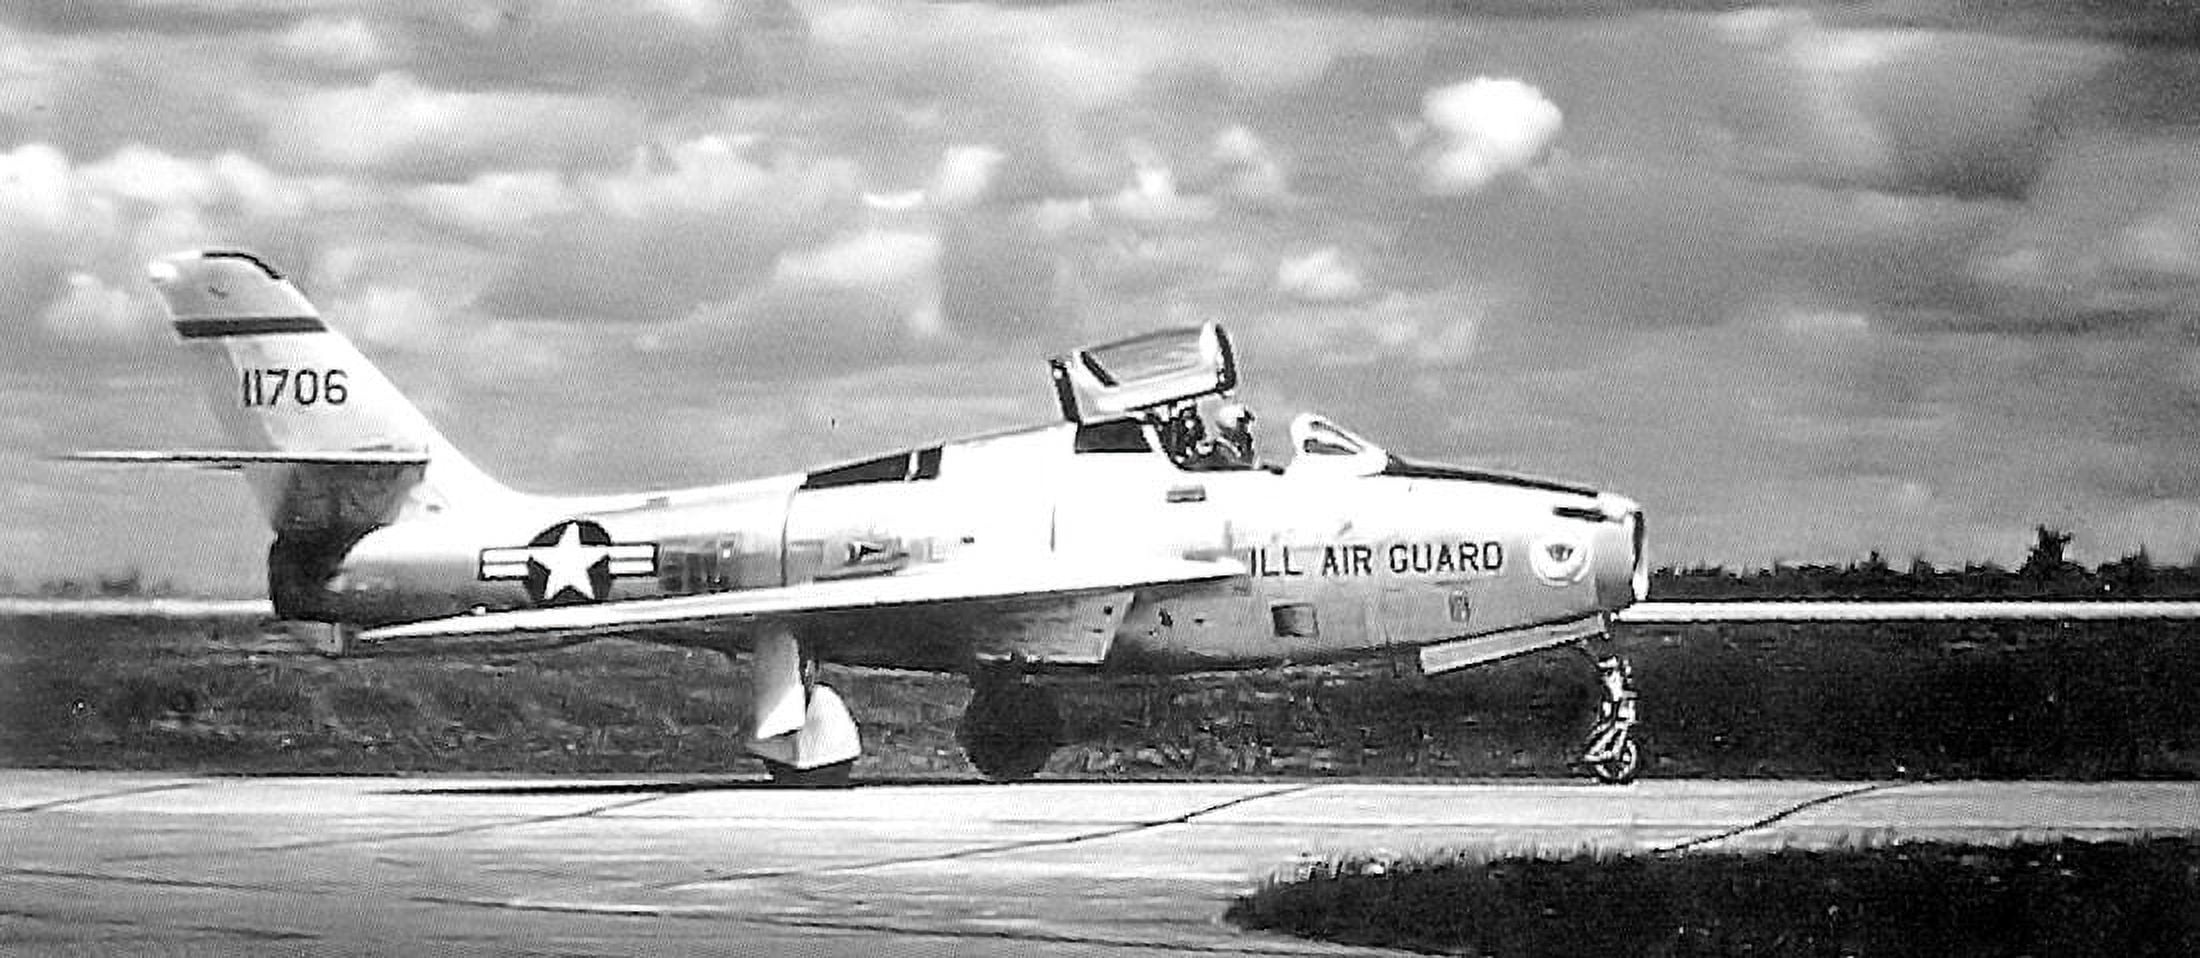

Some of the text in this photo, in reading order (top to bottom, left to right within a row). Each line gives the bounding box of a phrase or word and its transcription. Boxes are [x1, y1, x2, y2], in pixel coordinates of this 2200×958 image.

[242, 368, 349, 408] 11706
[1250, 540, 1504, 578] ILL AIR GUARD
